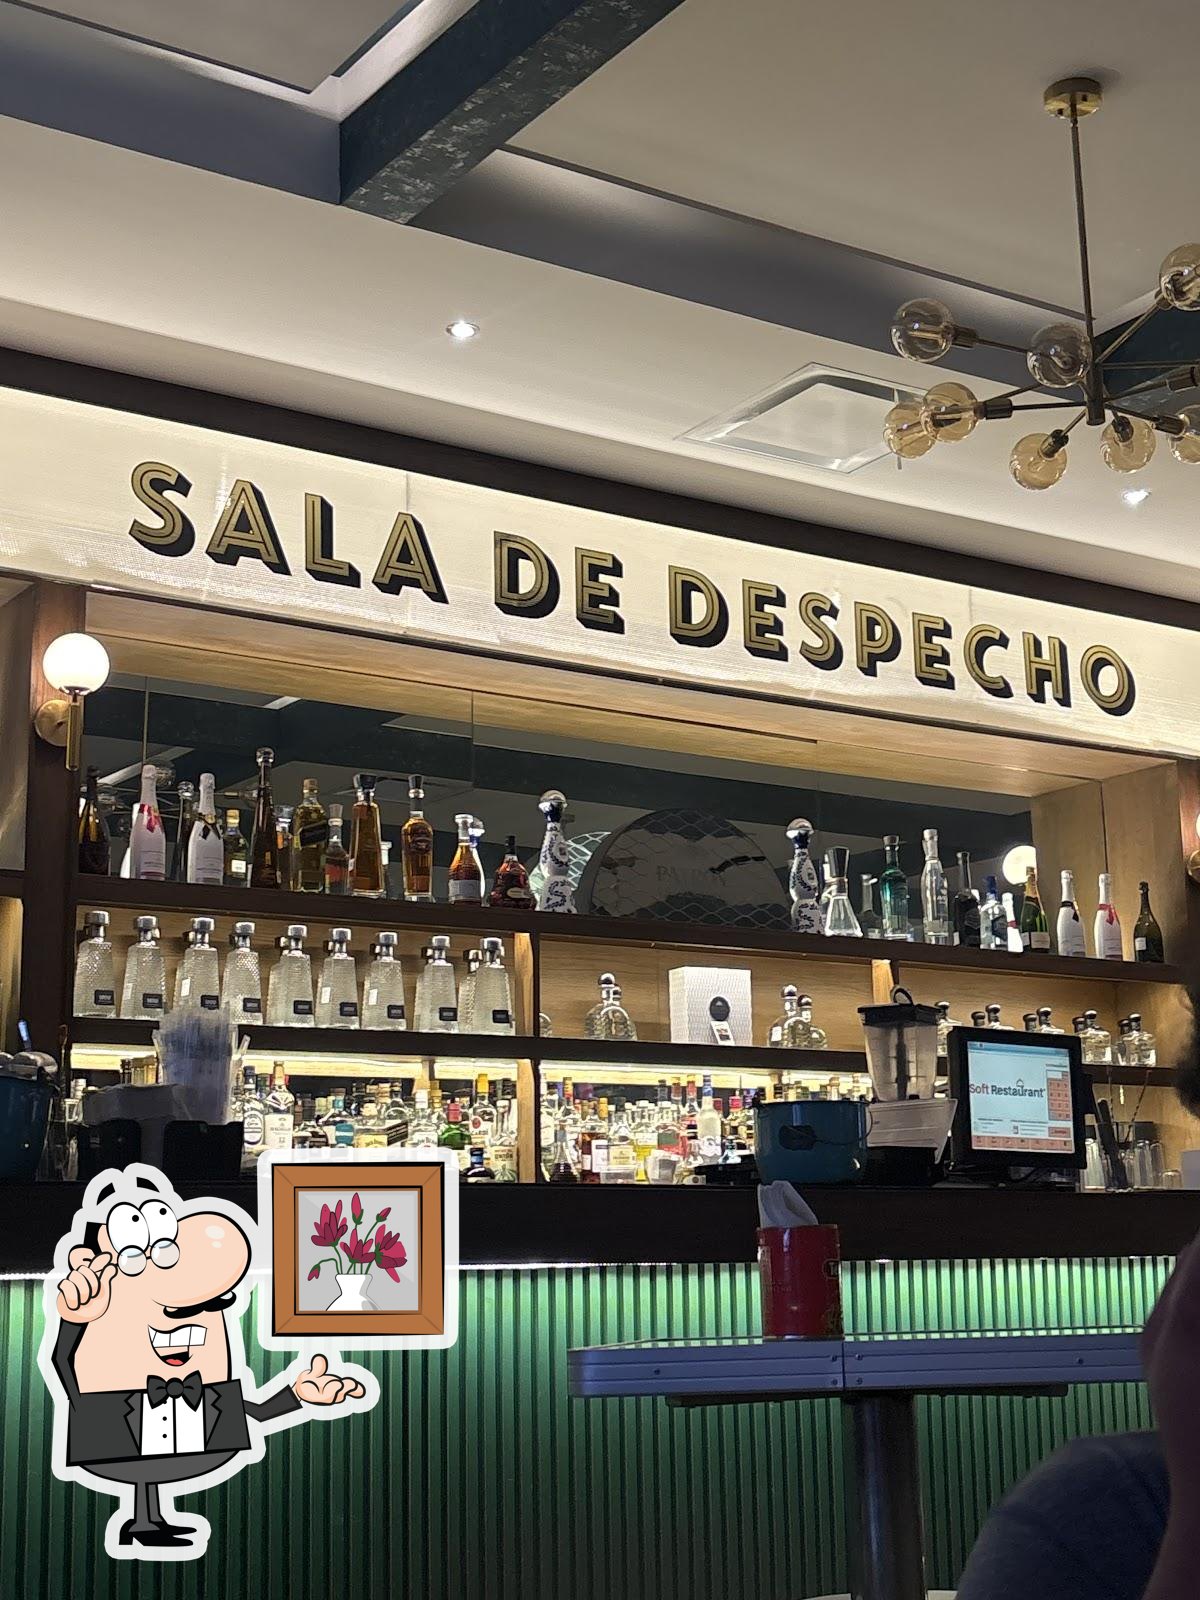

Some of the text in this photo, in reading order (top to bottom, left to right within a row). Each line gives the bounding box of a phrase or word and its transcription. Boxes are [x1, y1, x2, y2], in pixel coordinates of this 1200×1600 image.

[129, 461, 1135, 716] SALA DE DESPECHO
[969, 1083, 989, 1095] Soft
